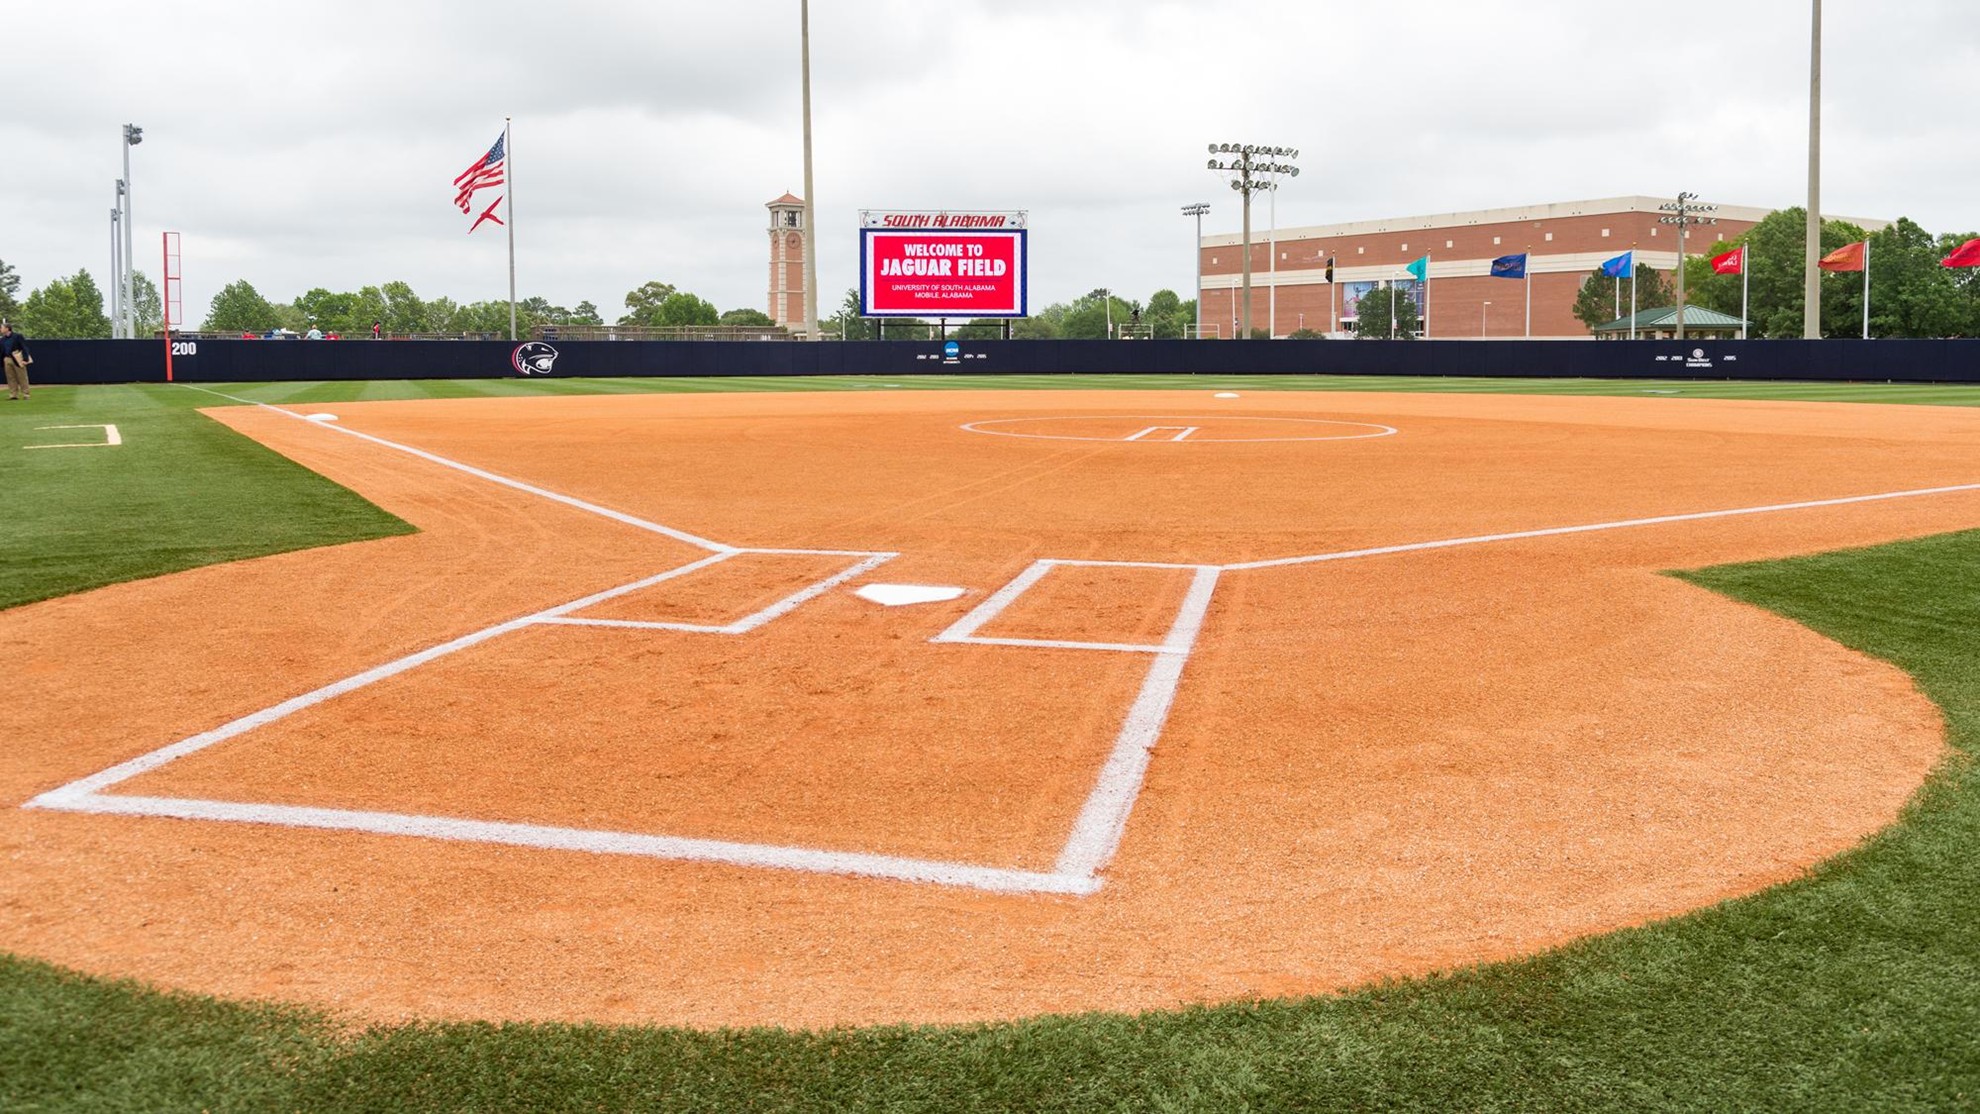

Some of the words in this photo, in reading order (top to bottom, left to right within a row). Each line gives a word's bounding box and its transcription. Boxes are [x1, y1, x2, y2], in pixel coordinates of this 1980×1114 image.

[882, 214, 931, 227] SOUTH
[932, 214, 1006, 227] ALABAMA
[904, 243, 963, 256] WELCOME
[966, 243, 983, 257] TO
[880, 258, 952, 276] JAGUAR
[957, 258, 1007, 277] FIELD
[171, 341, 197, 355] 200
